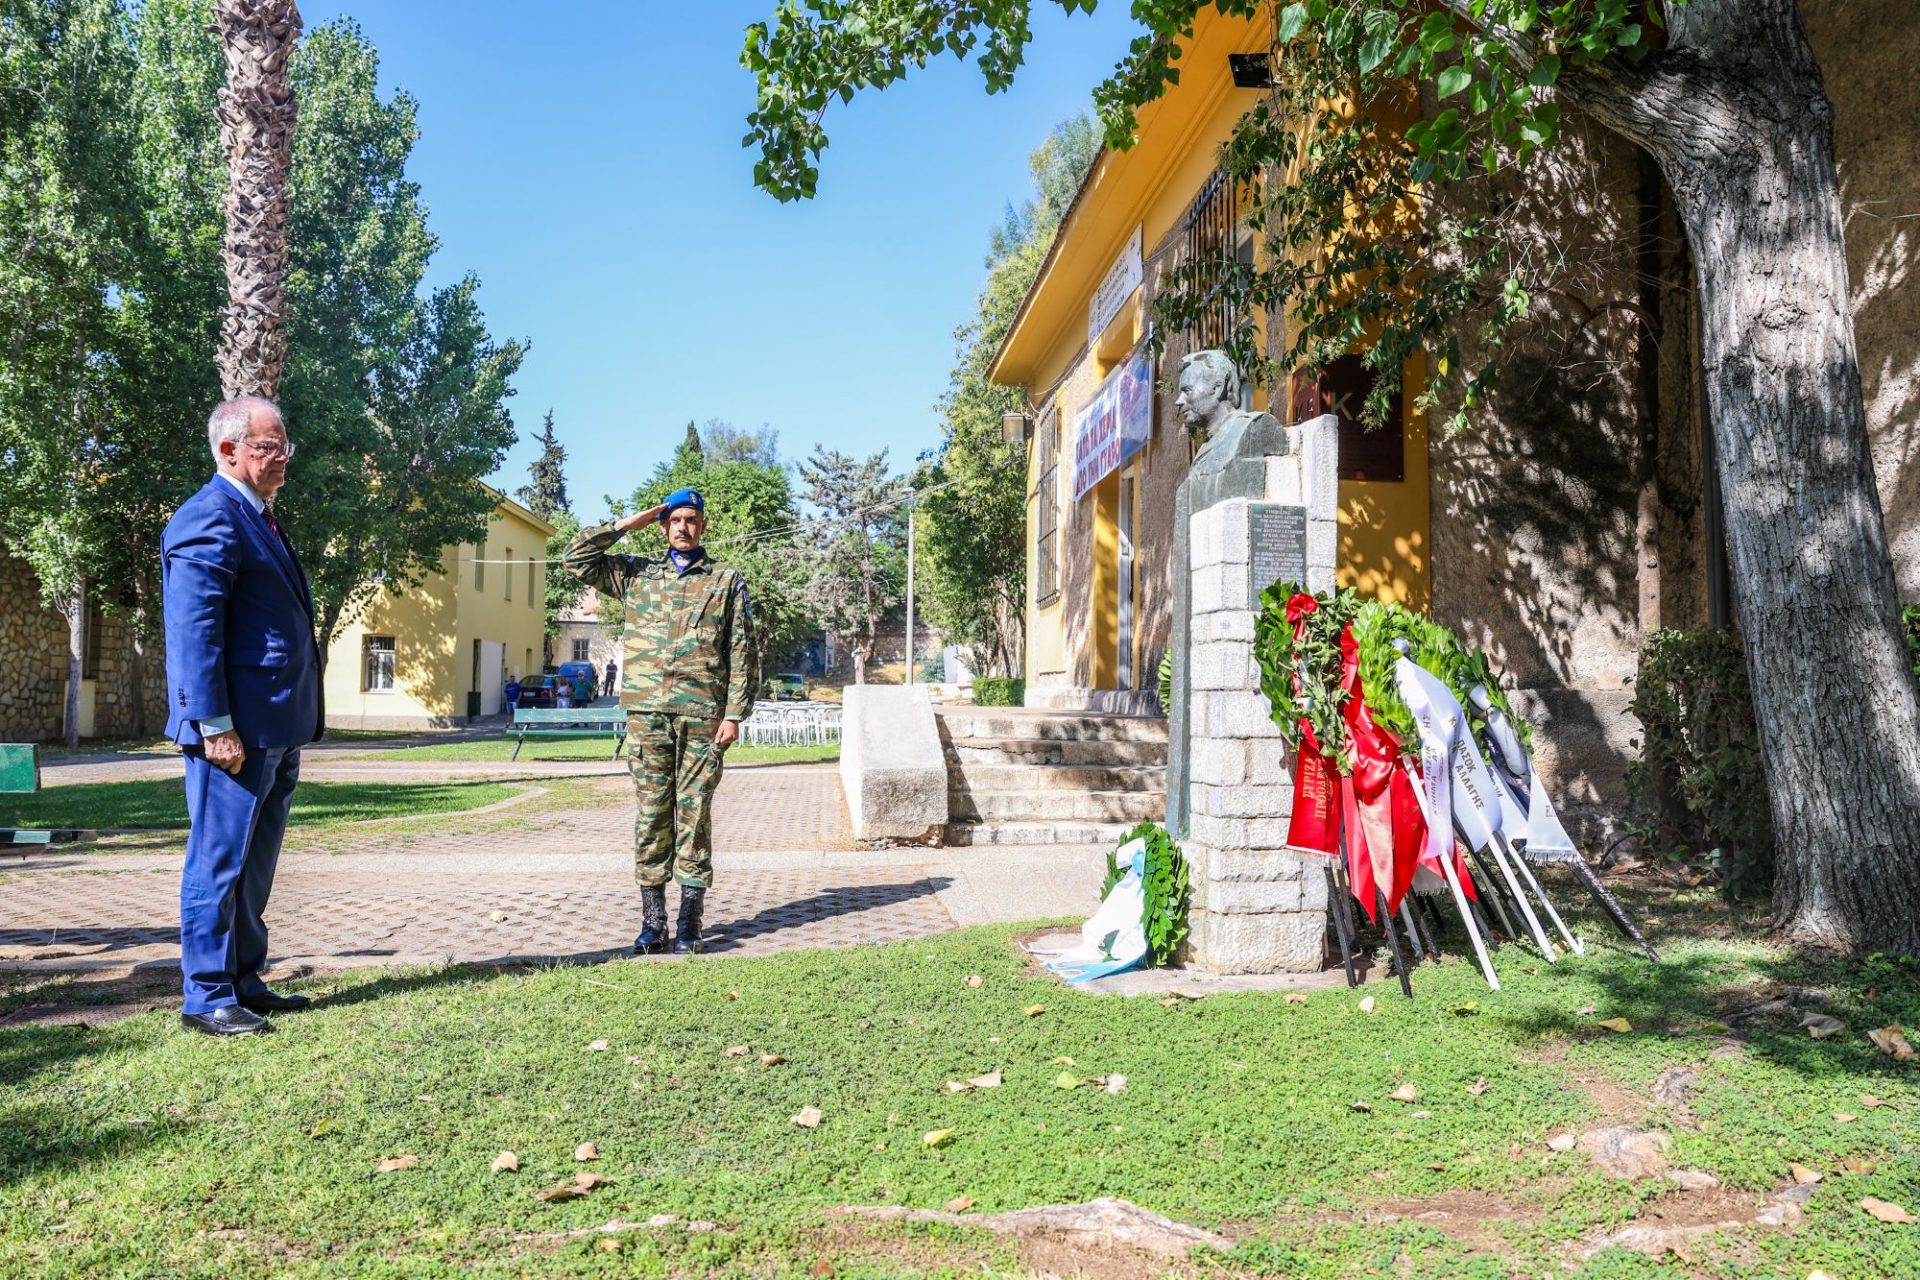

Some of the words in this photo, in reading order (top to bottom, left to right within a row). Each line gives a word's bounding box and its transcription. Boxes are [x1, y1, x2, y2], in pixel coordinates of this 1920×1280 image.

[1457, 739, 1477, 774] ΠΑΣΟΚ
[1302, 757, 1316, 799] ΣΥΡΙΖΑ
[1455, 764, 1485, 811] ΑΛΛΑΓΗΣ
